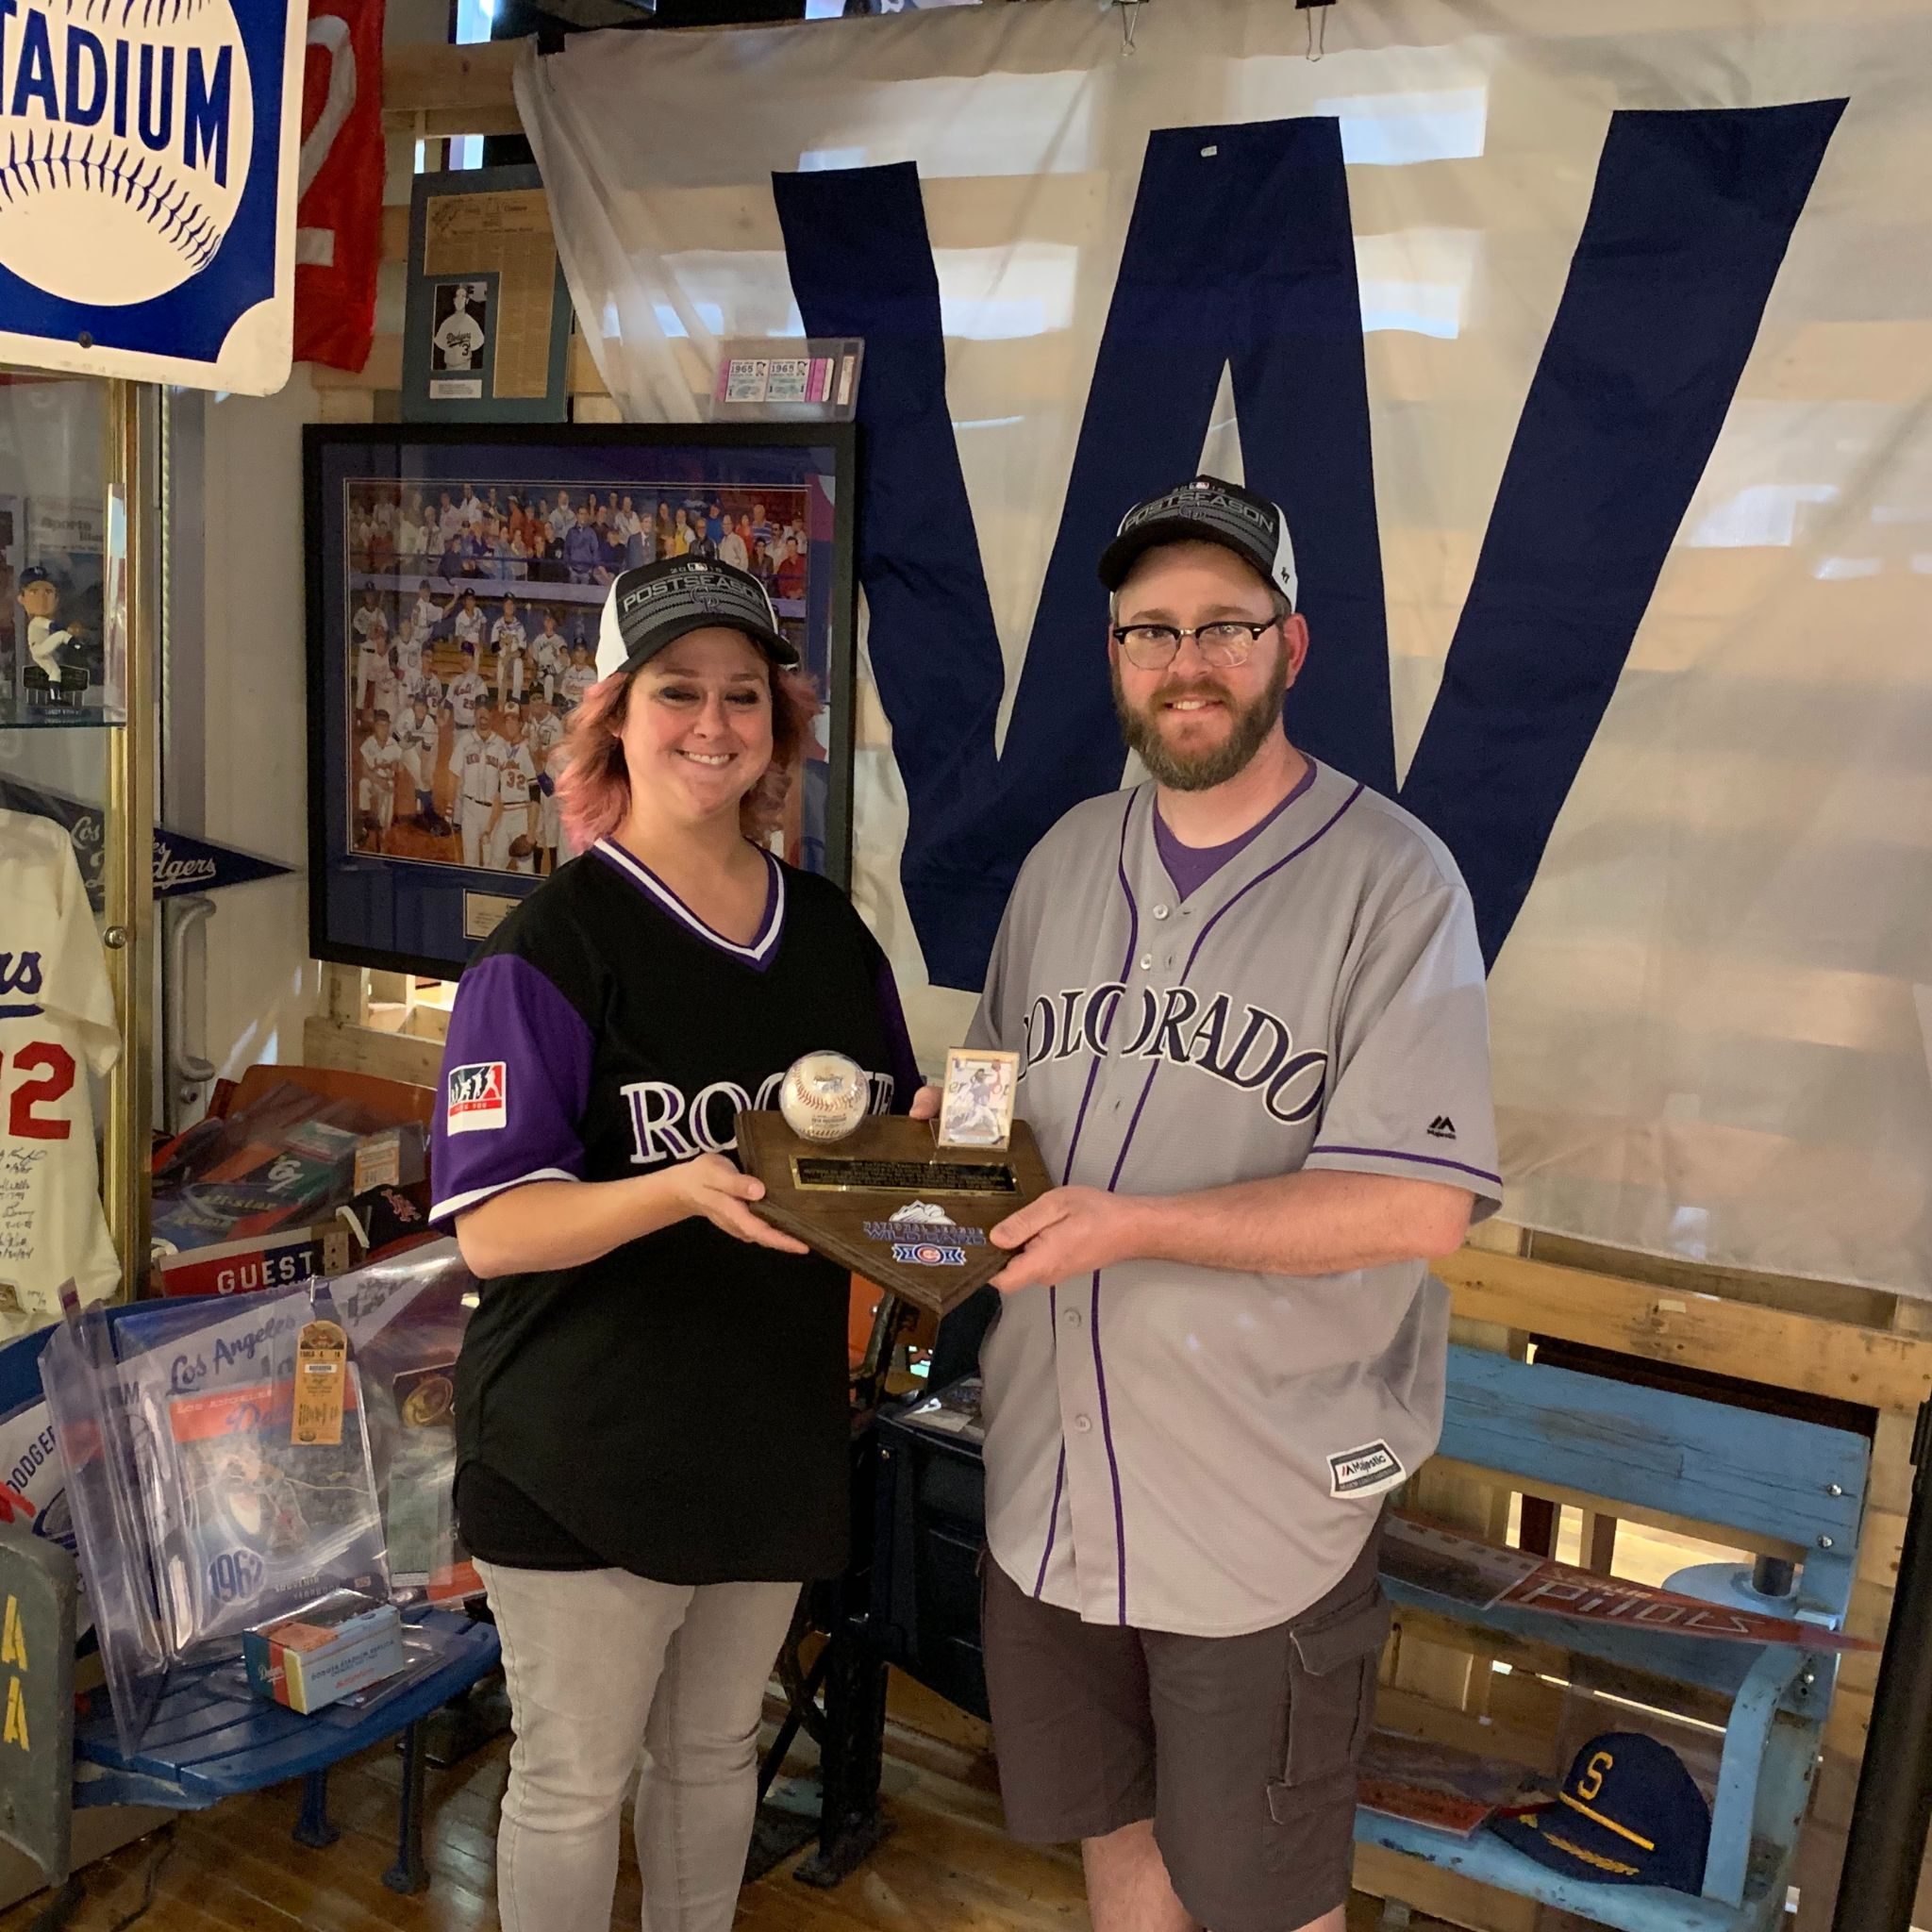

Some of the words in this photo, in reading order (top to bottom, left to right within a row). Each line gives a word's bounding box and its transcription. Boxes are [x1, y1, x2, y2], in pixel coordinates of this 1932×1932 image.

[730, 364, 754, 374] 1965
[771, 364, 794, 374] 1965
[1124, 491, 1274, 533] POSTSEASON
[772, 97, 1849, 990] W
[623, 574, 768, 613] POSTSEASON
[217, 1251, 313, 1295] GUEST
[165, 1354, 207, 1396] Los
[1351, 1454, 1387, 1474] Majestic
[1576, 1751, 1613, 1801] S
